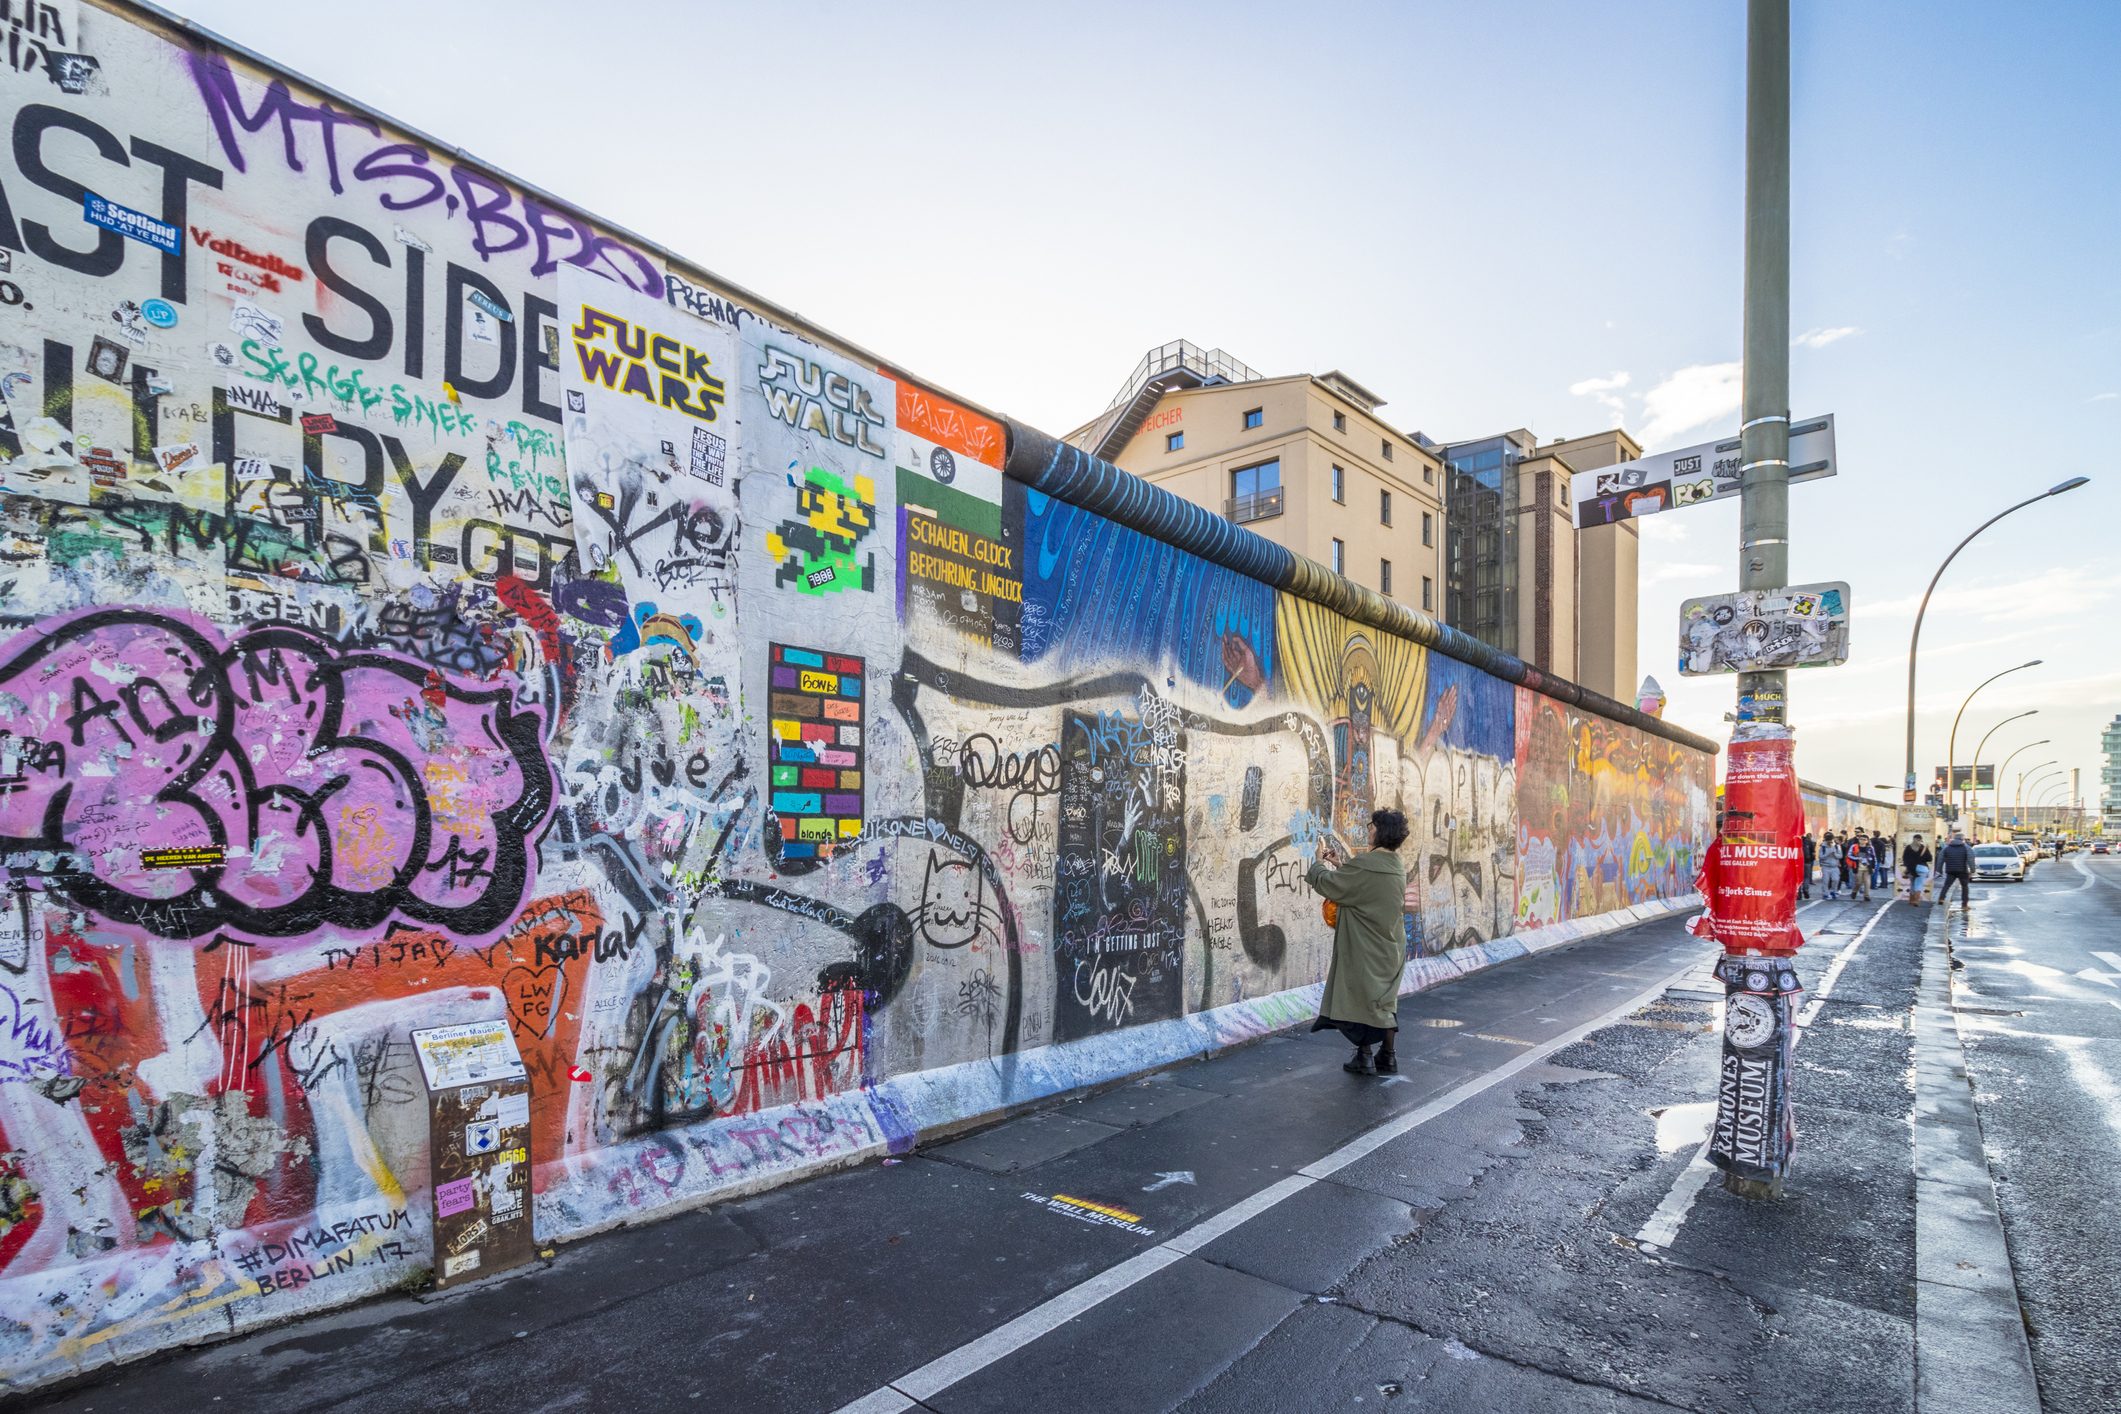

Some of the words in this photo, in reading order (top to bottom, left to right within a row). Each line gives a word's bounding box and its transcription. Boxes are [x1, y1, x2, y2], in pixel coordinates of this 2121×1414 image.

[90, 211, 115, 226] HUD
[136, 226, 150, 239] YE
[151, 234, 175, 249] BAM
[107, 204, 176, 241] Scotland
[150, 308, 169, 320] UP
[571, 303, 725, 393] FUCK
[572, 340, 726, 423] WARS
[758, 344, 885, 428] FUCK
[758, 380, 885, 460] WALL
[693, 428, 725, 452] JESUS
[692, 449, 705, 460] THE
[704, 454, 724, 467] TRUTH
[693, 440, 708, 453] THE
[708, 446, 725, 460] WAY
[690, 467, 708, 481] JOHN
[692, 457, 707, 470] THE
[707, 462, 723, 476] LIFE
[1675, 458, 1701, 472] JUST
[1754, 693, 1781, 701] MUCH
[157, 854, 182, 862] HEEREN
[197, 852, 222, 860] AMSTEL
[1735, 845, 1799, 859] MUSEUM
[1725, 886, 1744, 897] York
[1744, 886, 1772, 897] Times
[1105, 933, 1138, 953] GETTING
[1143, 932, 1161, 948] LOST
[520, 982, 553, 999] LW
[523, 1001, 550, 1017] FG
[594, 995, 618, 1008] ALICE
[431, 1031, 467, 1041] Berliner
[469, 1027, 496, 1035] Mauer
[1717, 1053, 1739, 1160] RAMONES
[1735, 1058, 1767, 1166] MUSEUM
[438, 1181, 471, 1200] party
[441, 1194, 471, 1209] fears
[1020, 1192, 1049, 1204] THE
[1046, 1200, 1086, 1215] WALL
[1086, 1211, 1156, 1236] MUSEUM
[233, 1209, 413, 1273] #DIMAFATUM
